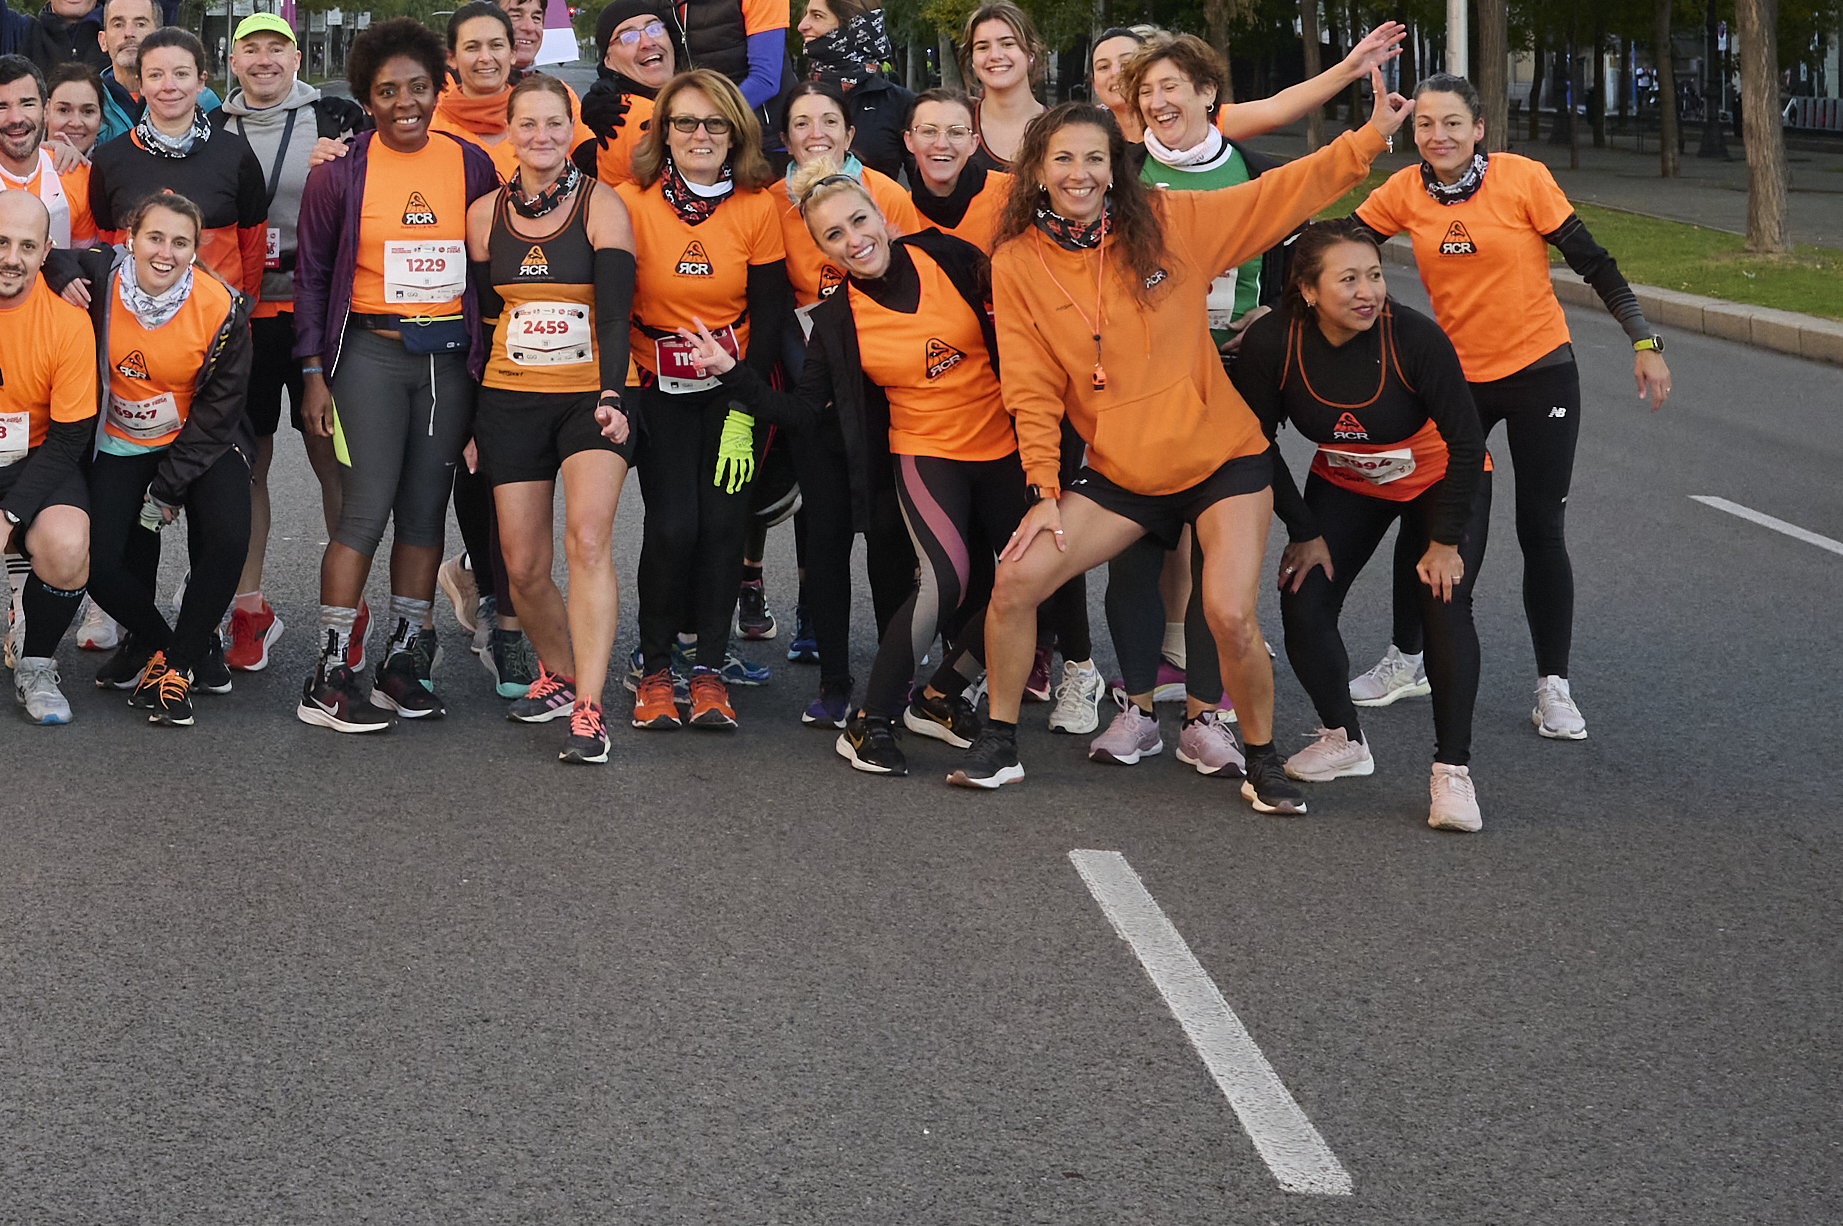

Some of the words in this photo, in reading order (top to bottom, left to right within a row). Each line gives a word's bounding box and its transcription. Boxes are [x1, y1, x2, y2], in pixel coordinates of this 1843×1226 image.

[405, 258, 447, 273] 1229
[523, 320, 570, 335] 2459
[113, 404, 157, 421] 6947
